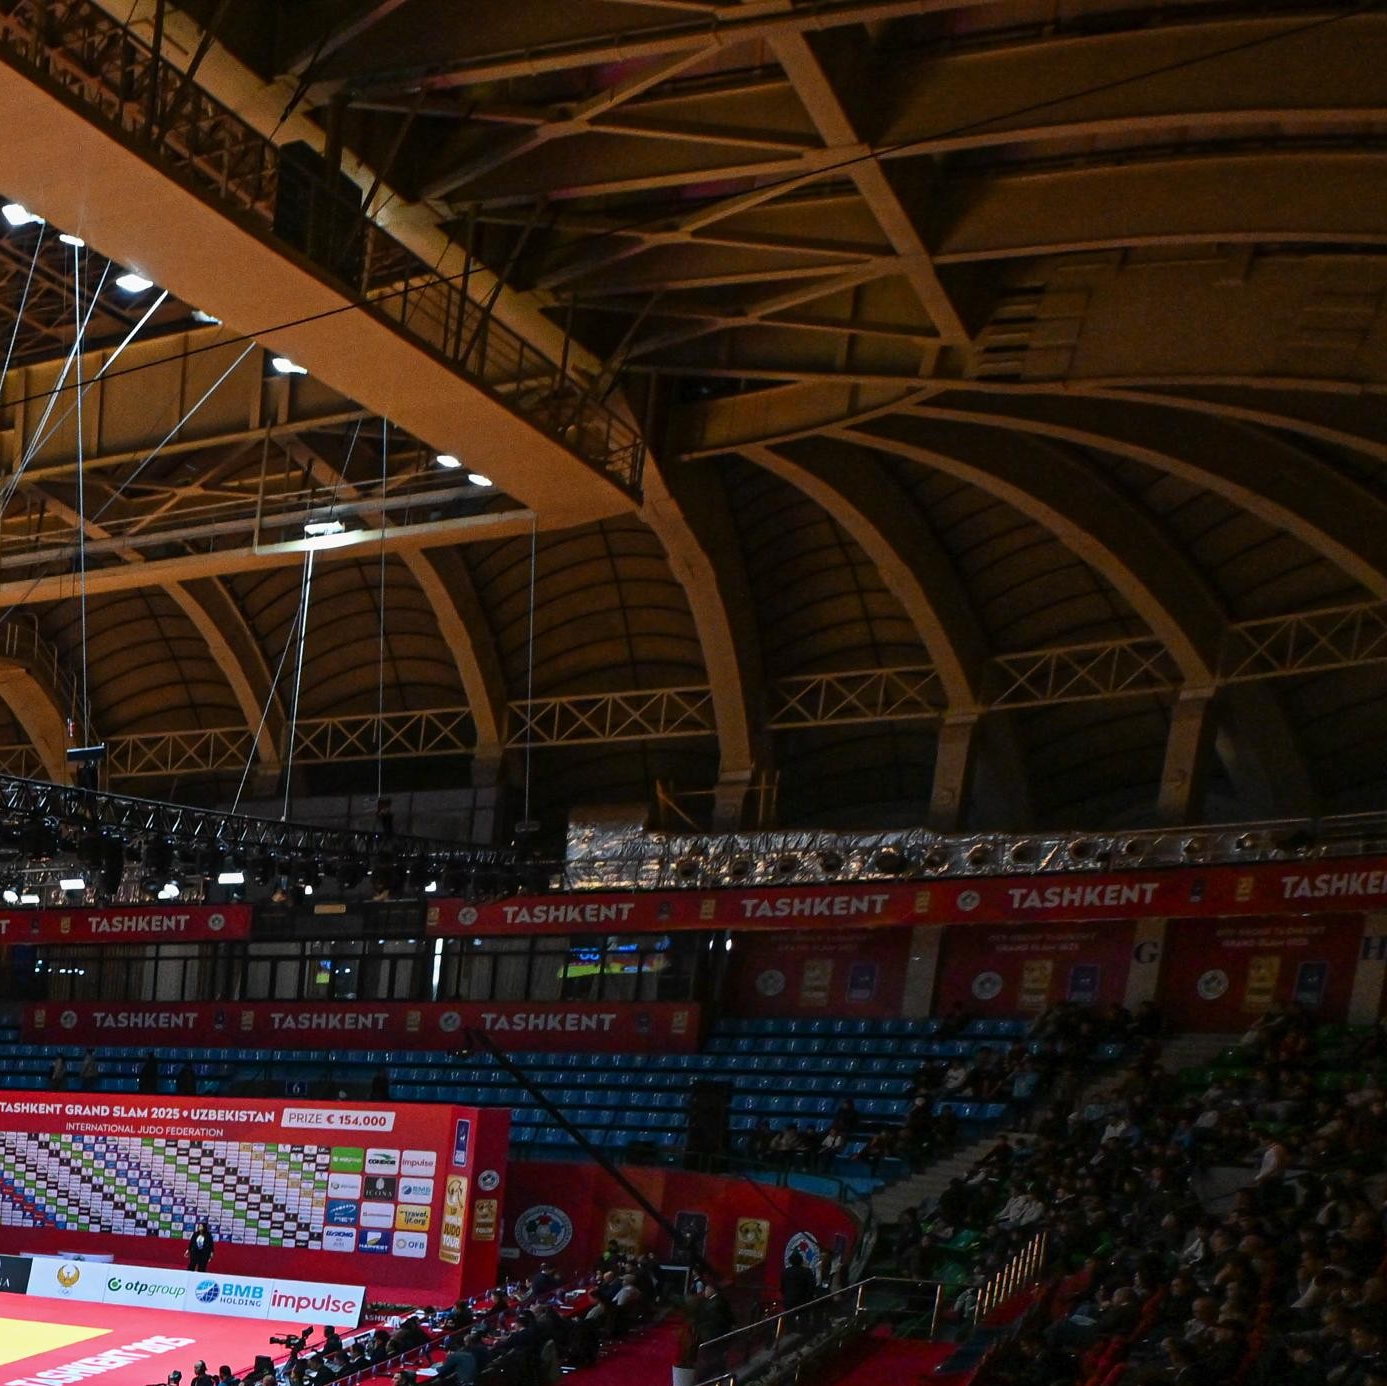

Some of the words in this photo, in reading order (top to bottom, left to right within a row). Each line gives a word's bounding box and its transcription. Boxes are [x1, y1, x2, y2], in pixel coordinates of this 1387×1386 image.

[1008, 883, 1159, 910] TASHKENT
[503, 903, 635, 924] TASHKENT
[741, 895, 889, 918] TASHKENT
[88, 914, 190, 934] TASHKENT
[1135, 941, 1159, 964] G
[92, 1012, 198, 1029] TASHKENT
[270, 1012, 389, 1030] TASHKENT
[481, 1013, 616, 1032] TASHKENT
[292, 1081, 301, 1095] 6
[0, 1102, 63, 1115] TASHKENT
[65, 1104, 110, 1117] GRAND
[112, 1106, 148, 1118] SLAM
[151, 1107, 180, 1119] 2025
[190, 1109, 275, 1123] UZBEKISTAN
[289, 1113, 322, 1125] PRIZE
[326, 1114, 335, 1125] €
[338, 1115, 387, 1128] 154,000
[65, 1122, 136, 1134] INTERNATIONAL
[137, 1125, 163, 1135] JUDO
[165, 1126, 224, 1137] FEDERATION
[443, 1223, 461, 1236] JUDO
[124, 1280, 186, 1298] otpgroup
[222, 1283, 263, 1299] BMB
[220, 1297, 261, 1308] HOLDING
[271, 1289, 356, 1314] impulse
